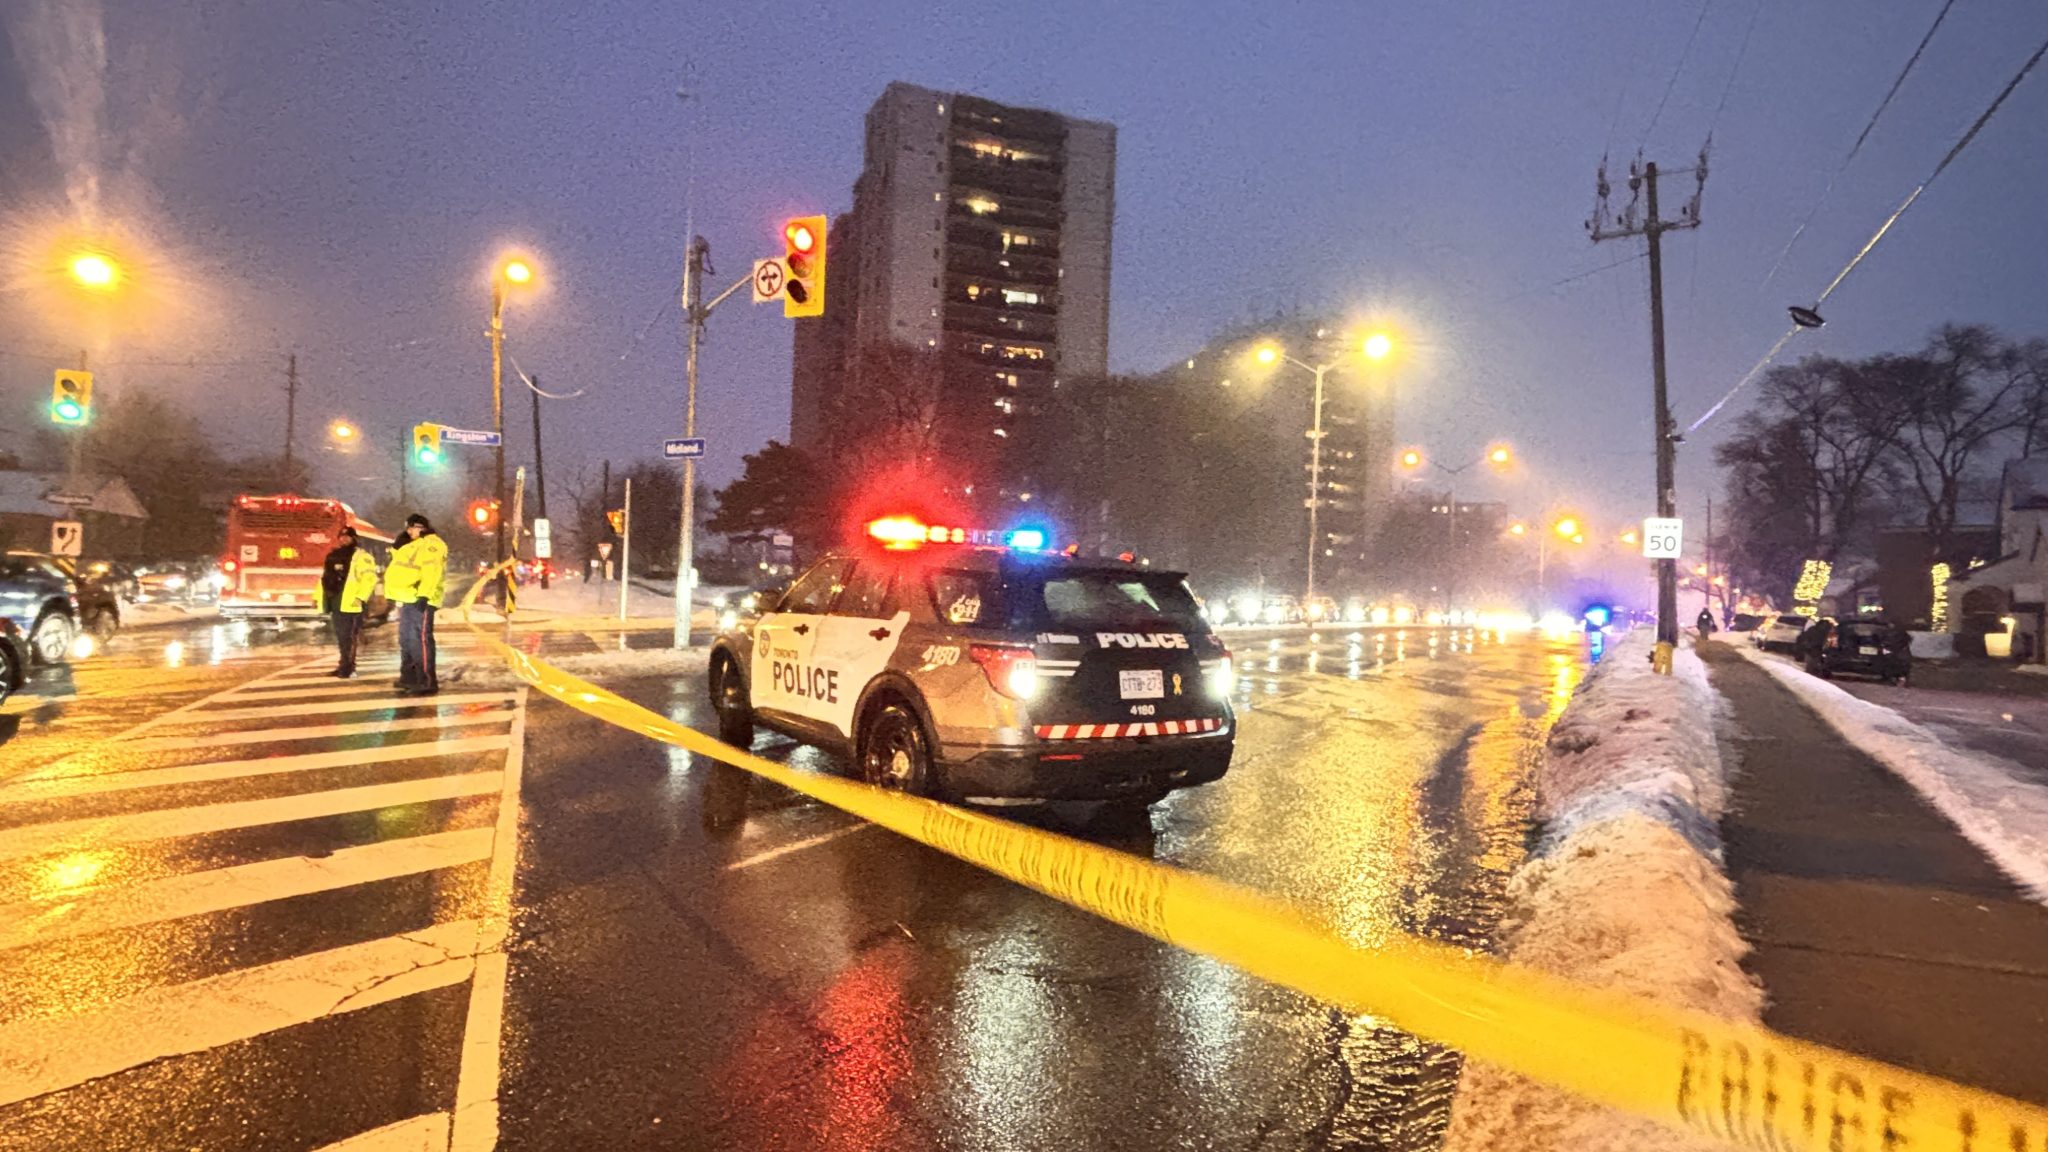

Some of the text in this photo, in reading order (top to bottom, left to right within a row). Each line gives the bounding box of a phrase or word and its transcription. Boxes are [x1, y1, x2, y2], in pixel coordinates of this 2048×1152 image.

[1650, 535, 1677, 552] 50
[1096, 632, 1190, 649] POLICE
[921, 645, 960, 666] 4180
[773, 661, 838, 704] POLICE
[1130, 704, 1156, 716] 4180
